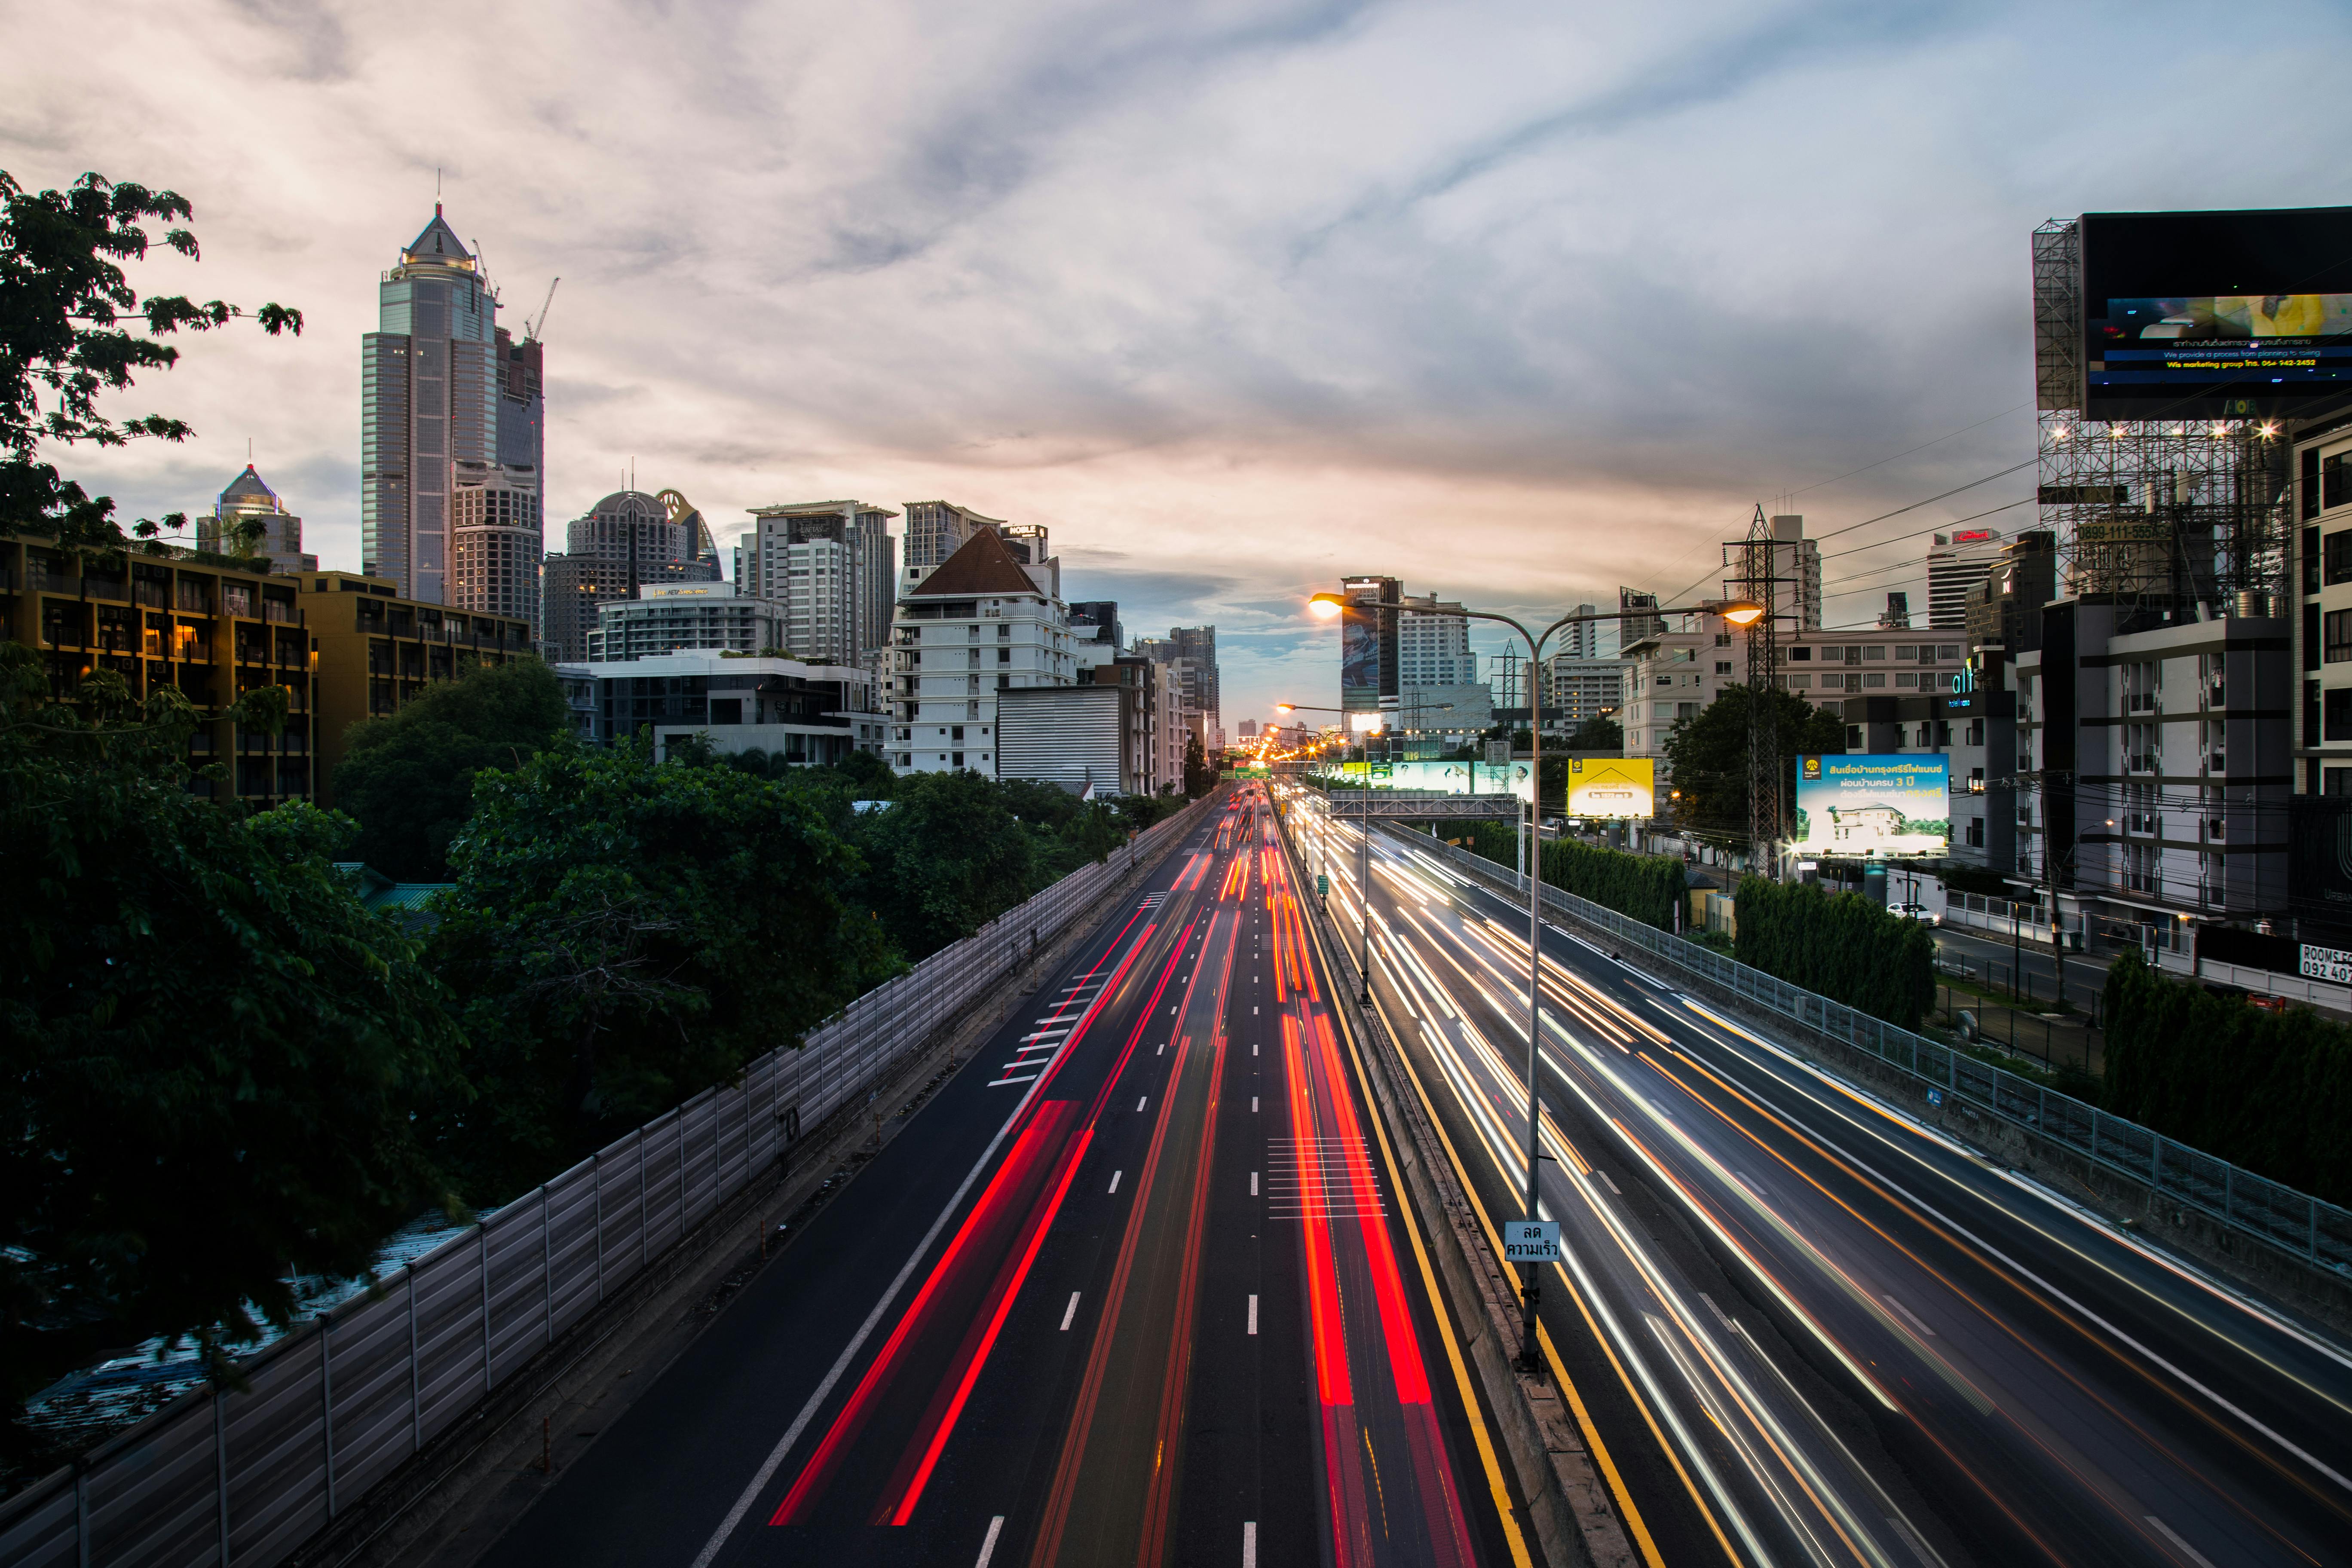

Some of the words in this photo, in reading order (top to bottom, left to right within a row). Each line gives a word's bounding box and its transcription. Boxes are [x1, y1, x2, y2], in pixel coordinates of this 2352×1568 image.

[2183, 361, 2220, 369] marketing
[1010, 525, 1036, 534] NOBLE
[1952, 668, 1974, 694] alt
[1896, 778, 1903, 787] 3
[1906, 776, 1914, 787] ปี
[2304, 946, 2339, 964] ROOMS
[2303, 961, 2326, 977] 092
[1524, 1227, 1541, 1238] ลด
[1507, 1240, 1558, 1255] ความเร็ว
